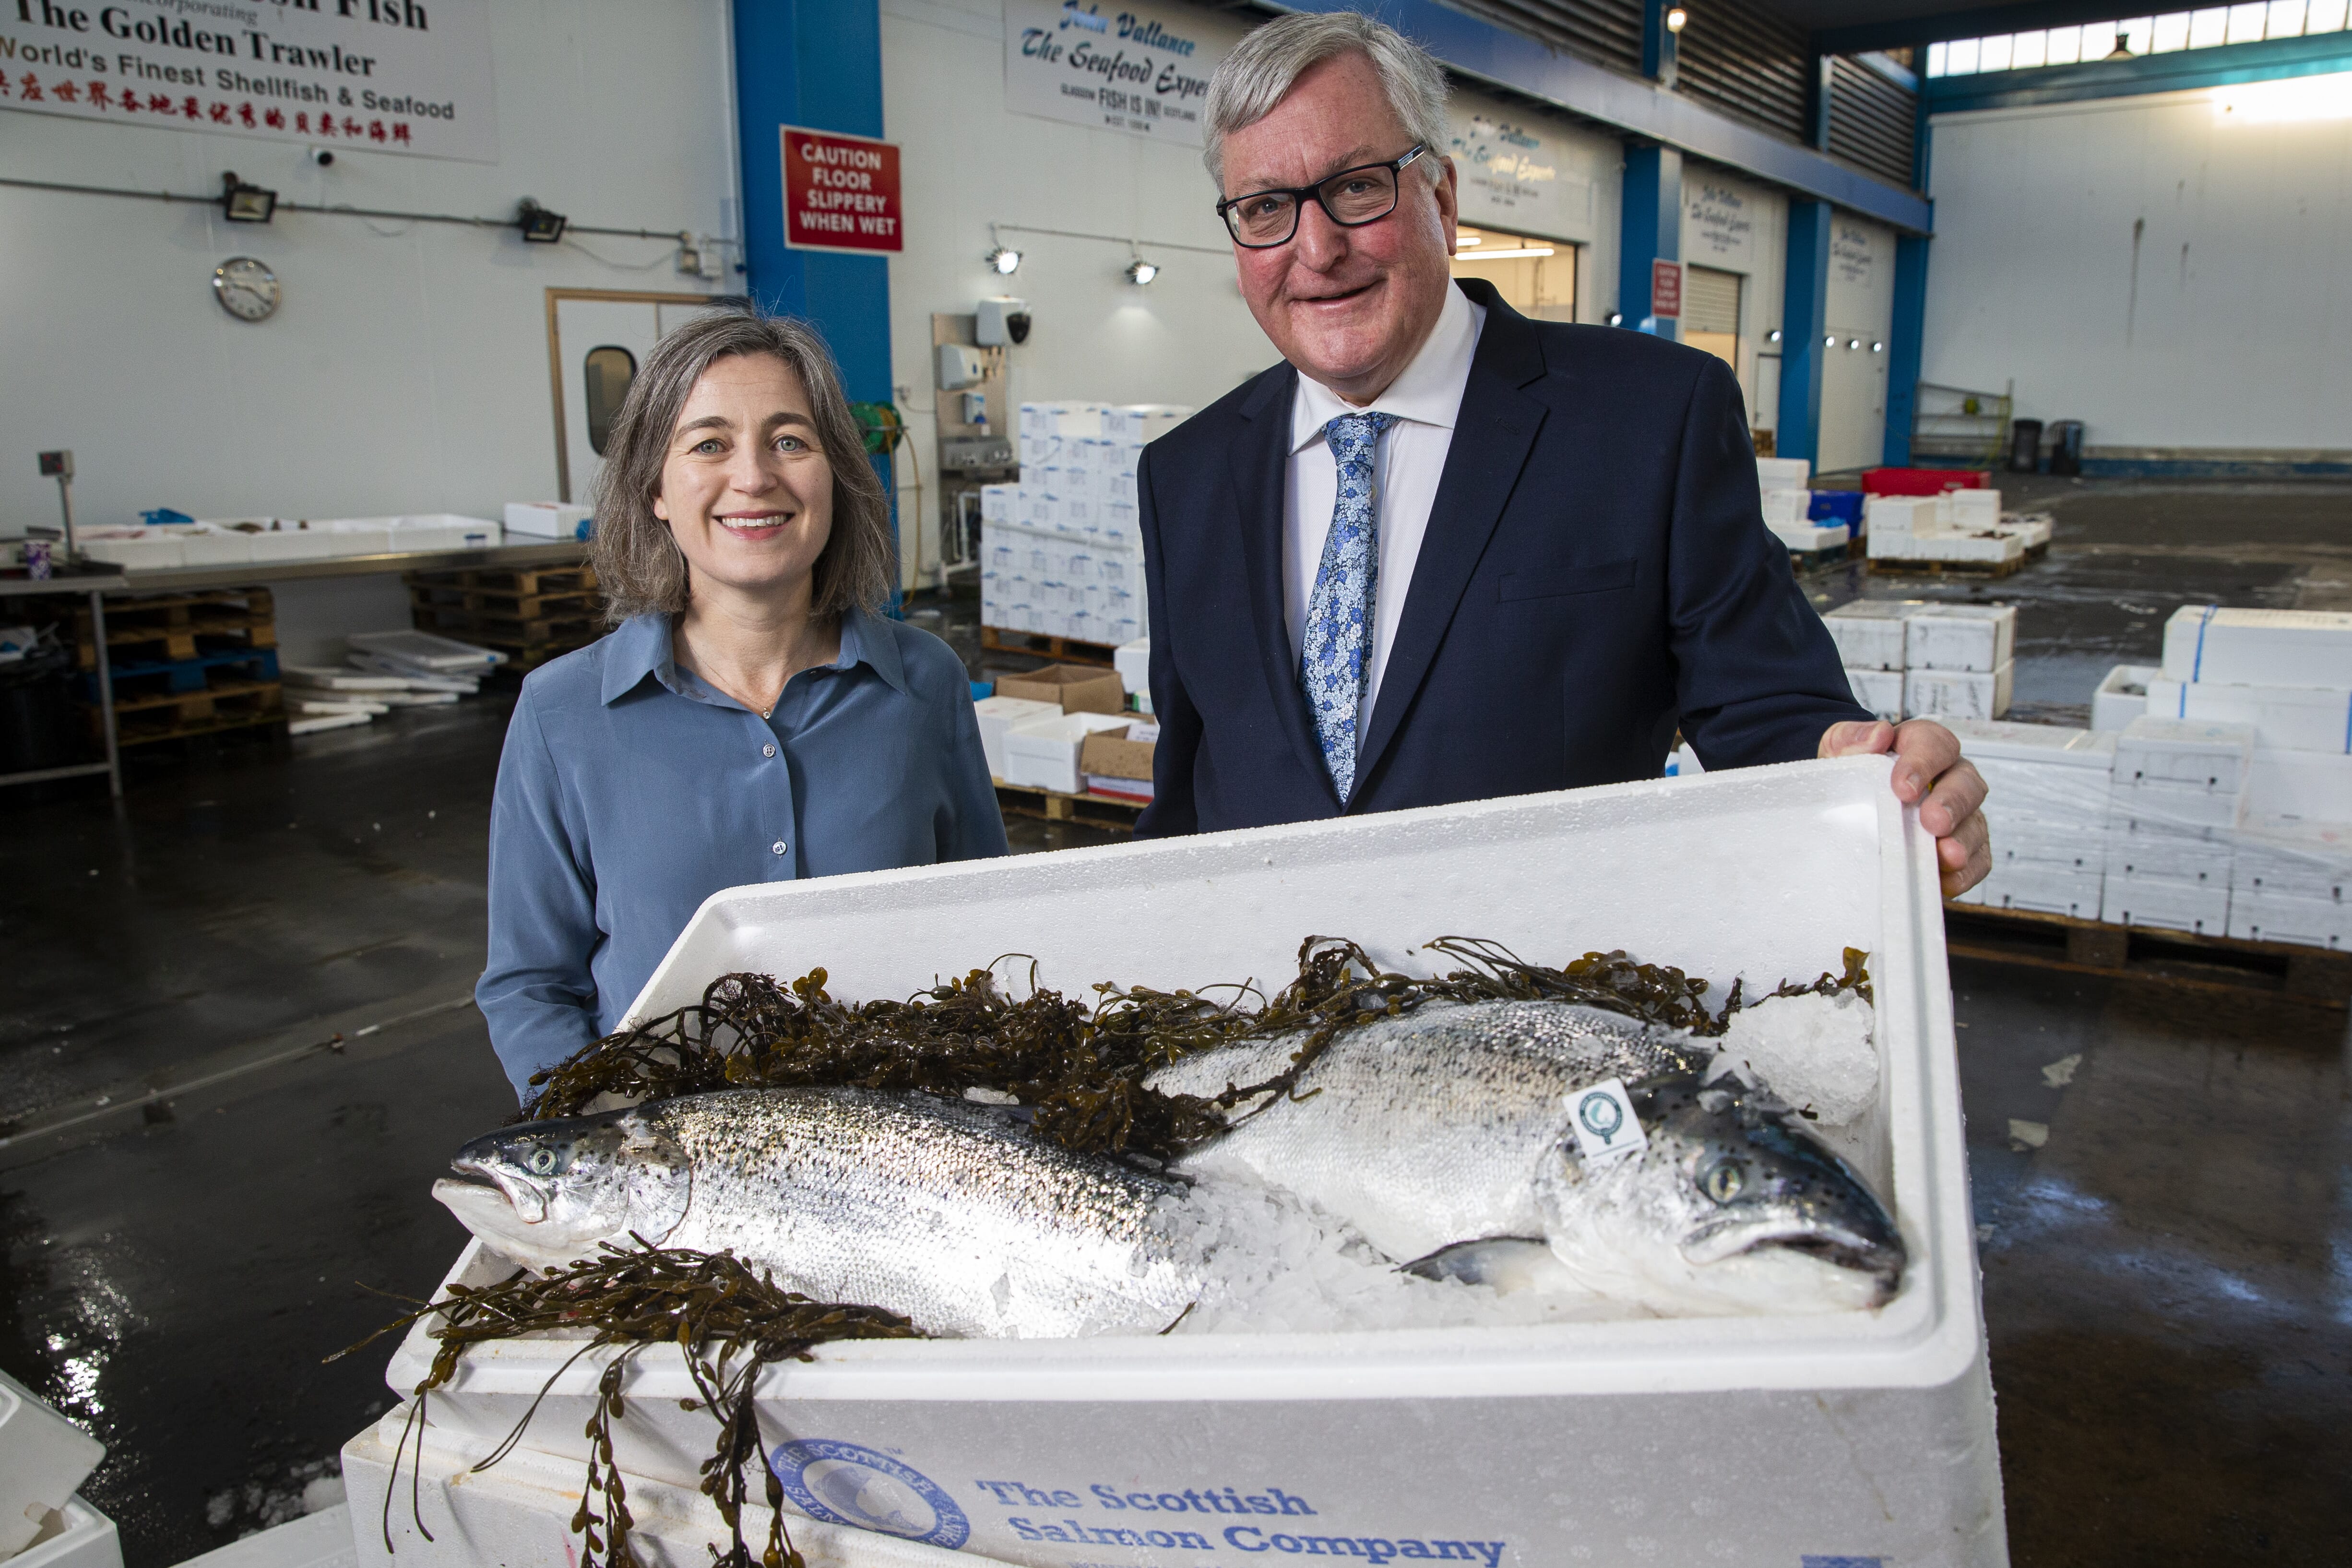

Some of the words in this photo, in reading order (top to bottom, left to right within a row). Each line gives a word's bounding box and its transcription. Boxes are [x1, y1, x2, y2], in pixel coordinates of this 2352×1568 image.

[17, 0, 90, 32] The
[99, 6, 236, 57] Golden
[241, 29, 376, 77] Trawler
[1022, 27, 1063, 62] The
[1069, 41, 1153, 83] Seafood
[1117, 12, 1196, 57] Vallance
[118, 53, 205, 87] Finest
[216, 69, 329, 103] Shellfish
[337, 86, 353, 107] &
[361, 89, 455, 120] Seafood
[1098, 86, 1128, 110] FISH
[801, 143, 881, 171] CAUTION
[812, 167, 871, 191] FLOOR
[807, 189, 887, 214] SLIPPERY
[799, 210, 855, 233] WHEN
[858, 215, 896, 236] WET
[777, 1446, 811, 1473] THE
[806, 1443, 938, 1494] SCOTTISH
[785, 1485, 847, 1526] SALM
[975, 1480, 1083, 1508] The
[1090, 1484, 1318, 1516] Scottish
[1008, 1517, 1215, 1550] Salmon
[1223, 1525, 1506, 1568] Company
